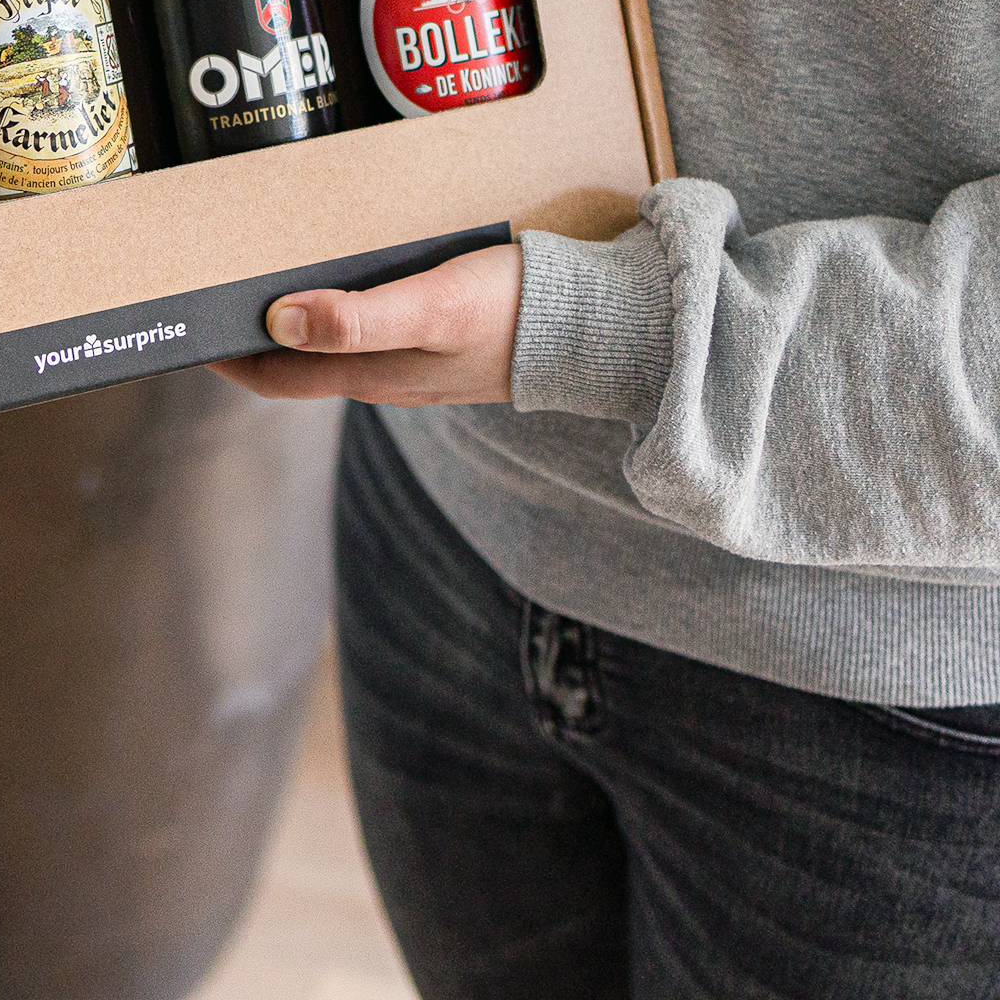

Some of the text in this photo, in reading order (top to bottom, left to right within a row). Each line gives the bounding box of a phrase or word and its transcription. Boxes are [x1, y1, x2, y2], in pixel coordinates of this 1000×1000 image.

[435, 73, 459, 98] DE
[459, 60, 522, 93] KONINCK
[209, 98, 315, 130] TRADITIONAL
[8, 175, 18, 185] de
[20, 177, 56, 188] l'ancien
[86, 168, 96, 178] de
[95, 153, 119, 173] Carmes
[32, 164, 68, 176] toujours
[97, 140, 113, 159] selon
